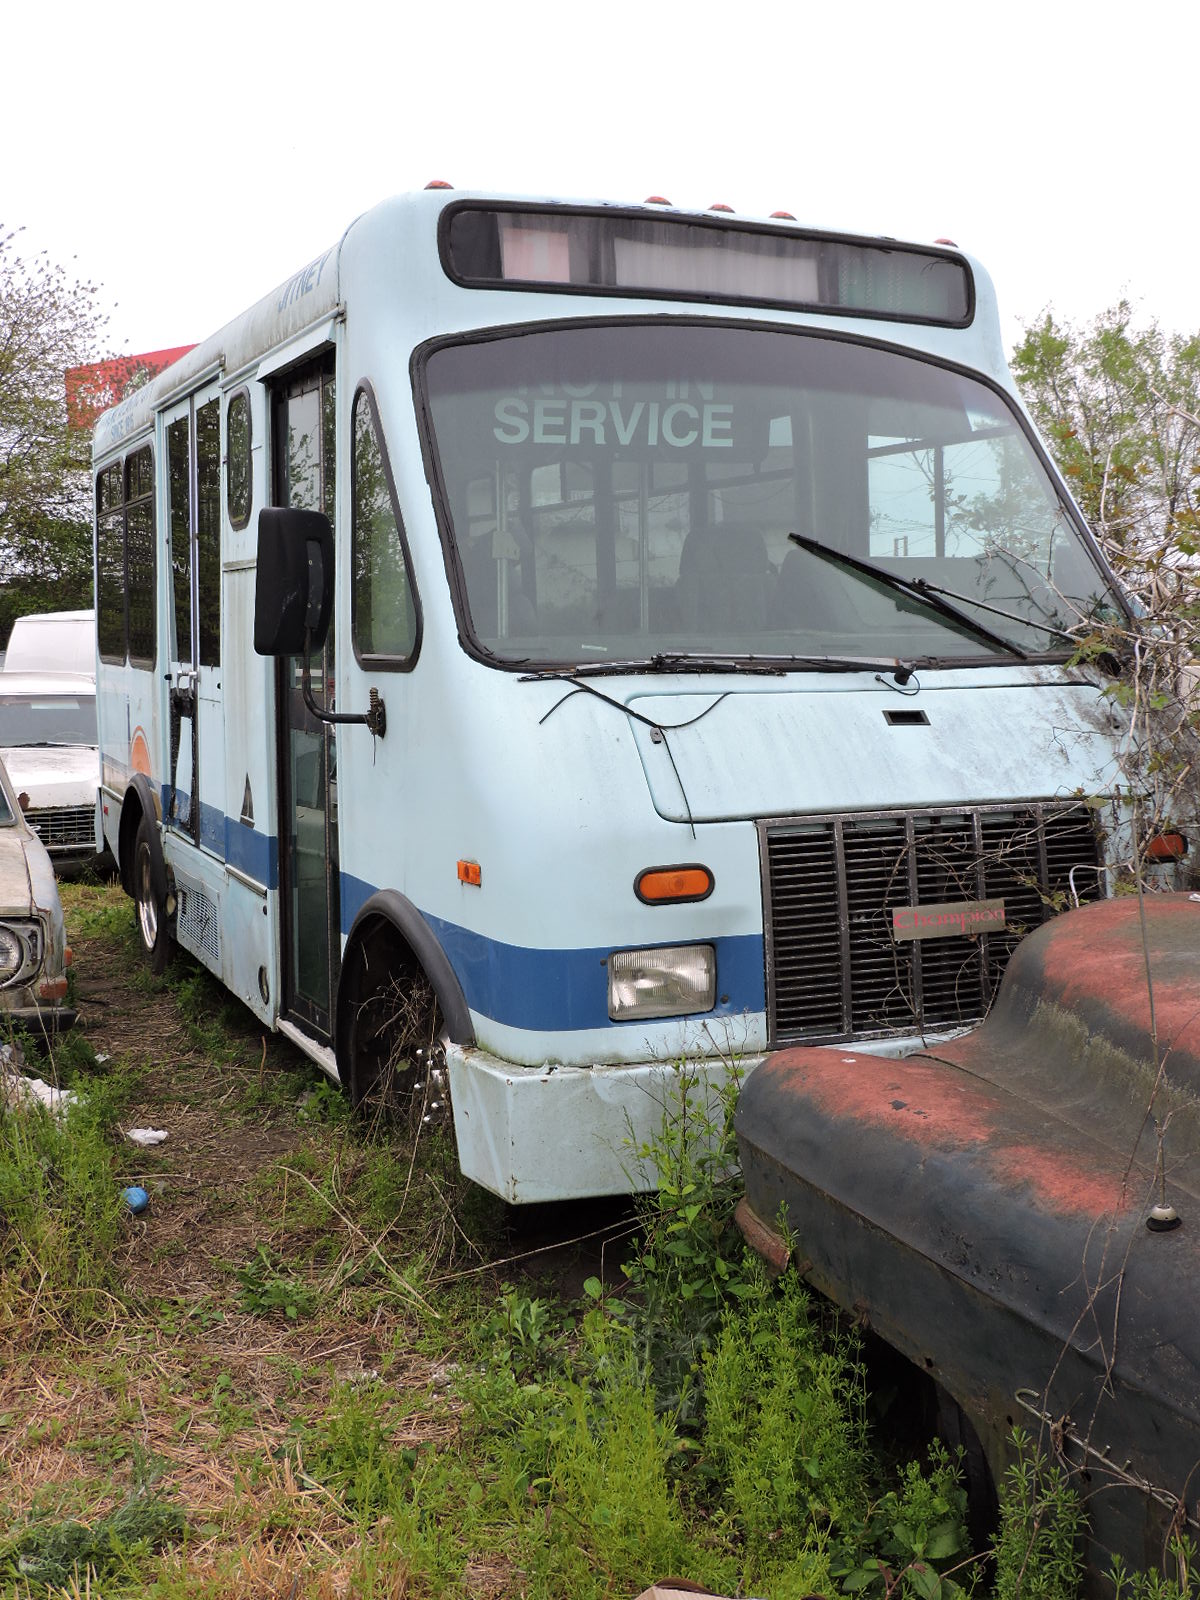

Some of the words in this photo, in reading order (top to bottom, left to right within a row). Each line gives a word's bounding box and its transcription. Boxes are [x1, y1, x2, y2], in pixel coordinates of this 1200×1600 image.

[278, 250, 332, 313] JITNEY
[493, 398, 734, 448] SERVICE
[893, 908, 1005, 933] Champion
